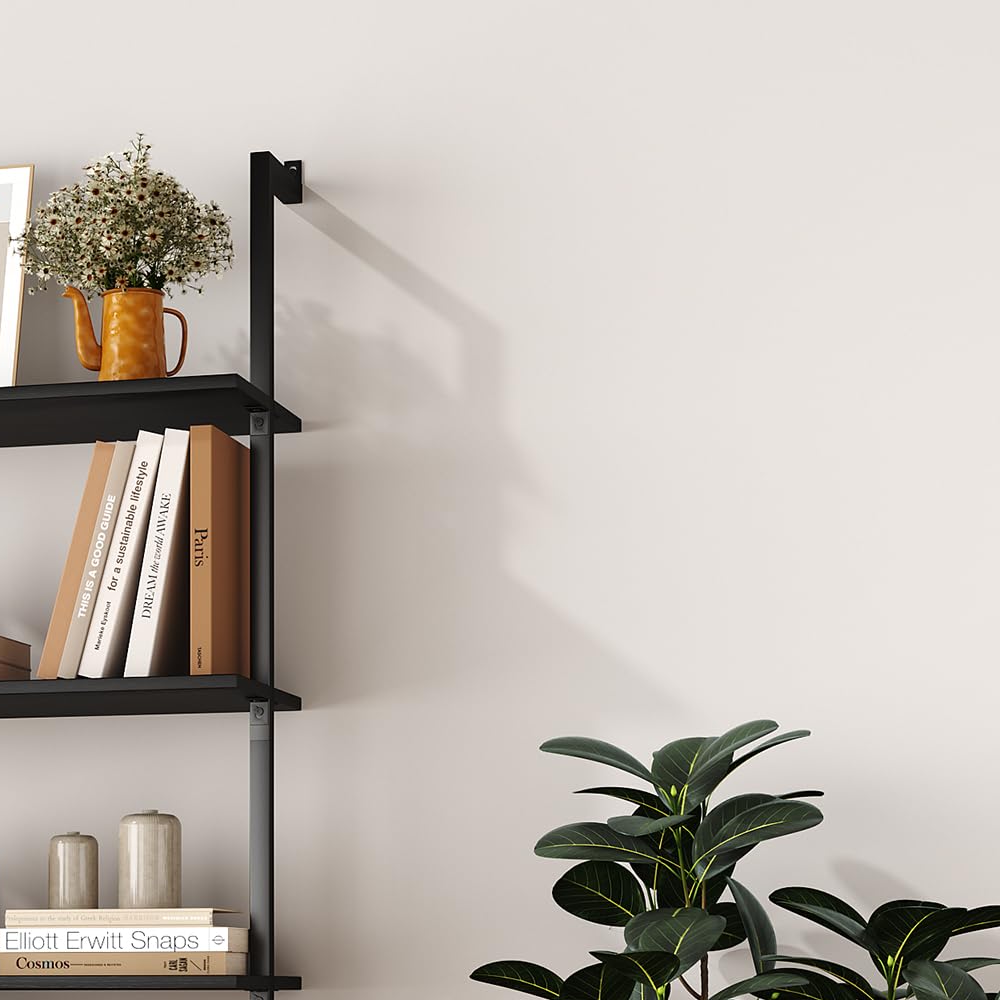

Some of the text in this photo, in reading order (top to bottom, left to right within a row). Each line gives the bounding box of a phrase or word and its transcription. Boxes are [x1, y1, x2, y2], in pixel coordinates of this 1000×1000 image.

[77, 493, 116, 618] THIS IS A GOOD GUIDE
[107, 460, 149, 592] for a sustainable lifestyle
[141, 492, 172, 619] DREAM the world AWAKE
[194, 528, 209, 567] Paris
[5, 930, 199, 952] Elliott Erwitt Snaps
[16, 956, 70, 970] Cosmos
